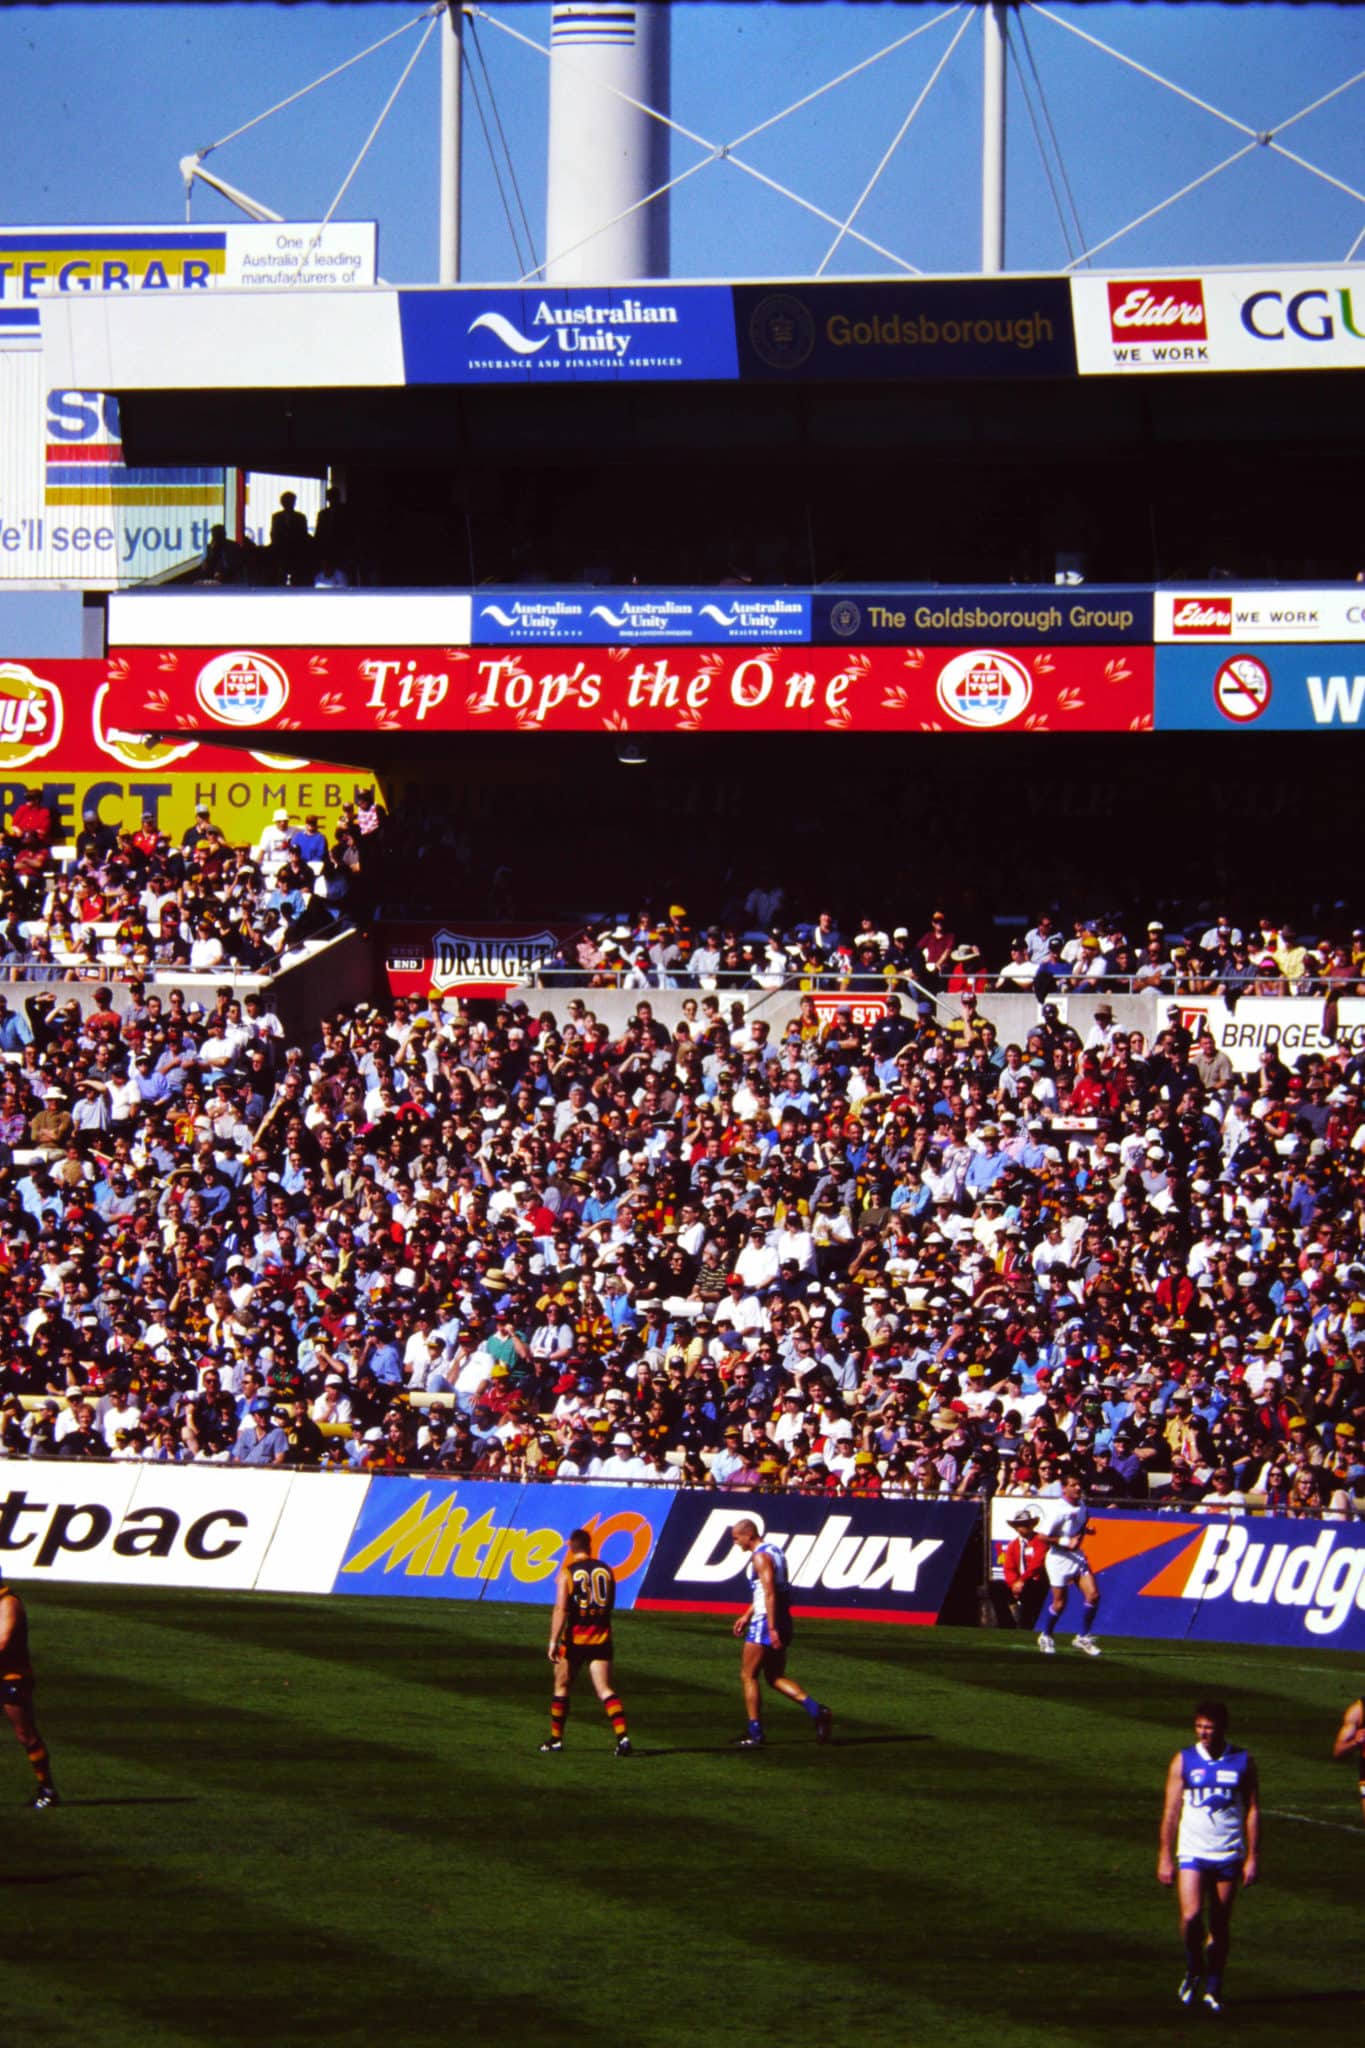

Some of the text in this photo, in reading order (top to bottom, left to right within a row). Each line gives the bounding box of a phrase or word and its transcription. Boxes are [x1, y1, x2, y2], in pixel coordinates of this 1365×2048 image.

[276, 234, 323, 249] One of
[314, 252, 362, 269] leading
[342, 270, 356, 284] of
[533, 299, 679, 326] Australian
[1112, 288, 1203, 328] Elders
[825, 315, 1054, 349] Goldsborough
[555, 328, 632, 356] Unity
[1114, 346, 1209, 362] WE WORK
[468, 357, 683, 369] INSURANCE AND FINANCIAL SERVICES
[0, 518, 43, 552] e'll
[52, 527, 114, 552] see
[122, 526, 183, 562] you
[511, 600, 583, 615] Australian
[620, 600, 693, 615] Australian
[729, 599, 804, 614] Australian
[1173, 602, 1231, 628] Elders
[521, 615, 559, 630] Unity
[630, 615, 669, 630] Unity
[739, 614, 778, 629] Unity
[868, 606, 1134, 632] The Goldsborough Group
[1235, 610, 1319, 623] WE WORK
[227, 682, 256, 692] TOP
[229, 674, 255, 683] TIP
[363, 659, 850, 720] Tip Top's the One
[0, 690, 47, 743] y's
[393, 959, 417, 969] END
[439, 943, 552, 977] DRAUGHT
[816, 1007, 881, 1025] WST
[341, 1490, 564, 1583] Mitre
[573, 1567, 611, 1608] 30
[1181, 1523, 1365, 1635] Budg
